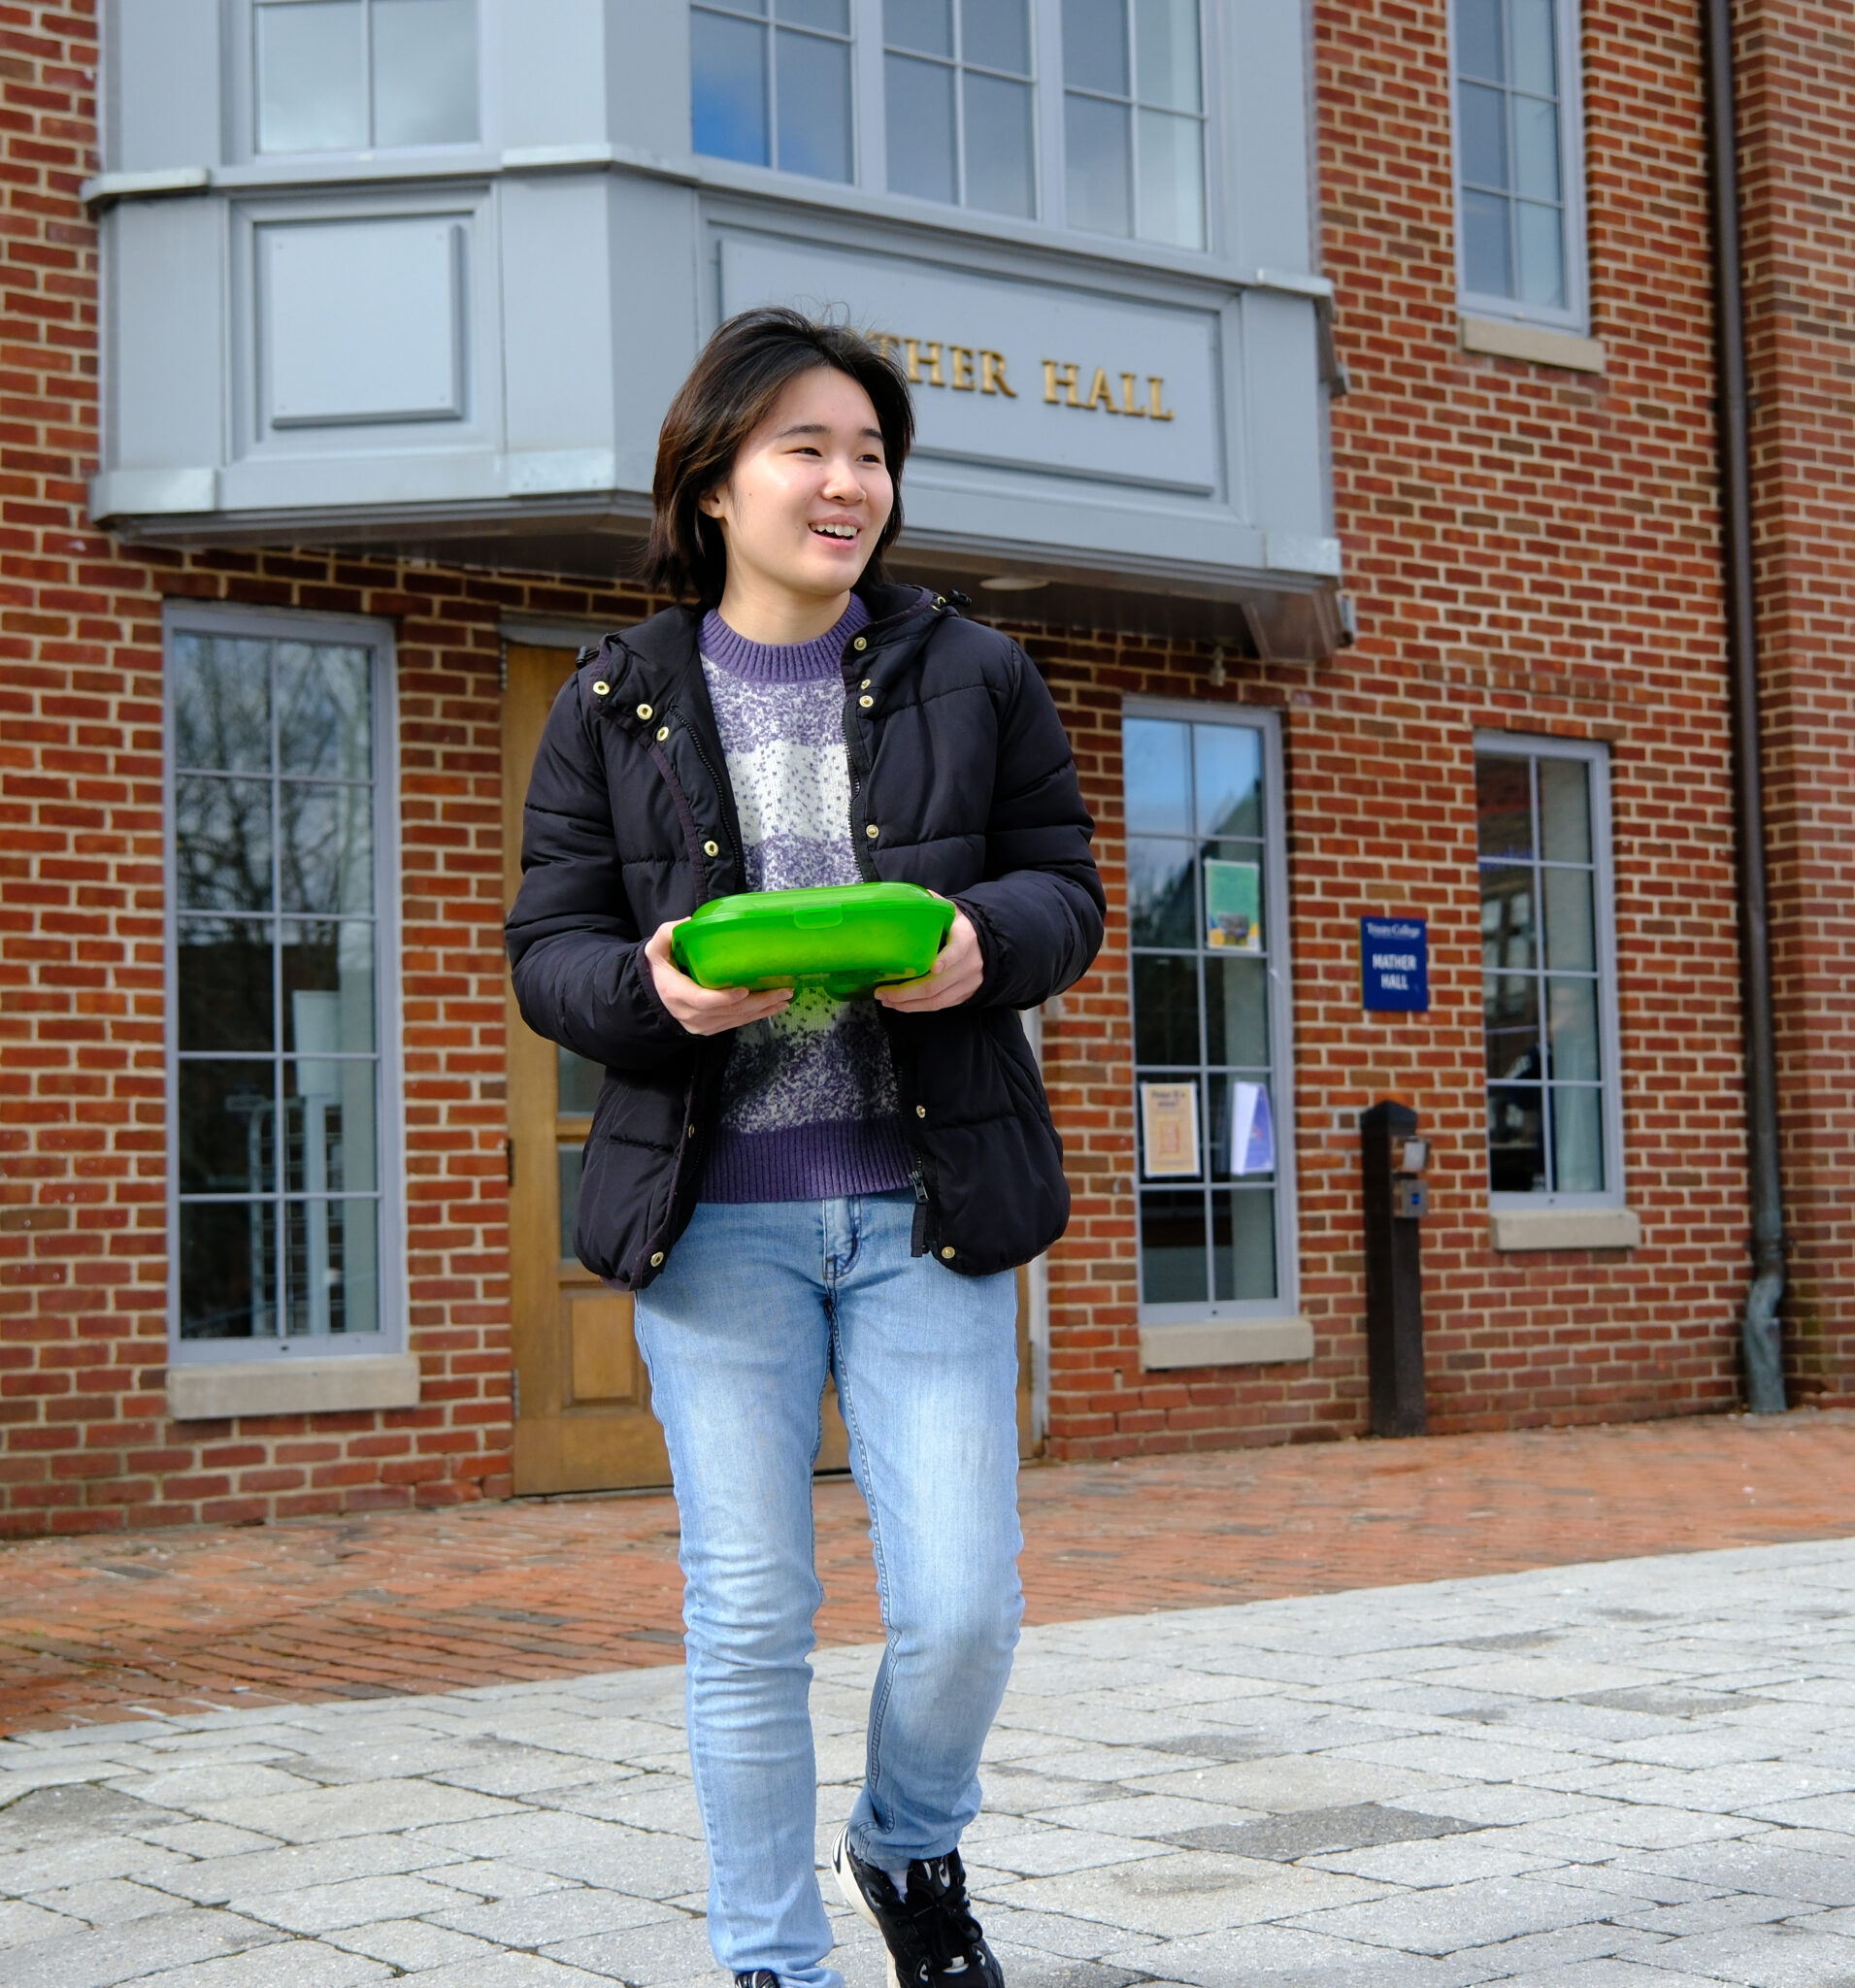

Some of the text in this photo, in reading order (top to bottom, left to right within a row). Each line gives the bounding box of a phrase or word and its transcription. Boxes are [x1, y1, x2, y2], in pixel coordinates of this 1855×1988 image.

[866, 332, 1175, 420] THER HALL
[1372, 953, 1417, 972] MATHER
[1380, 973, 1409, 990] HALL
